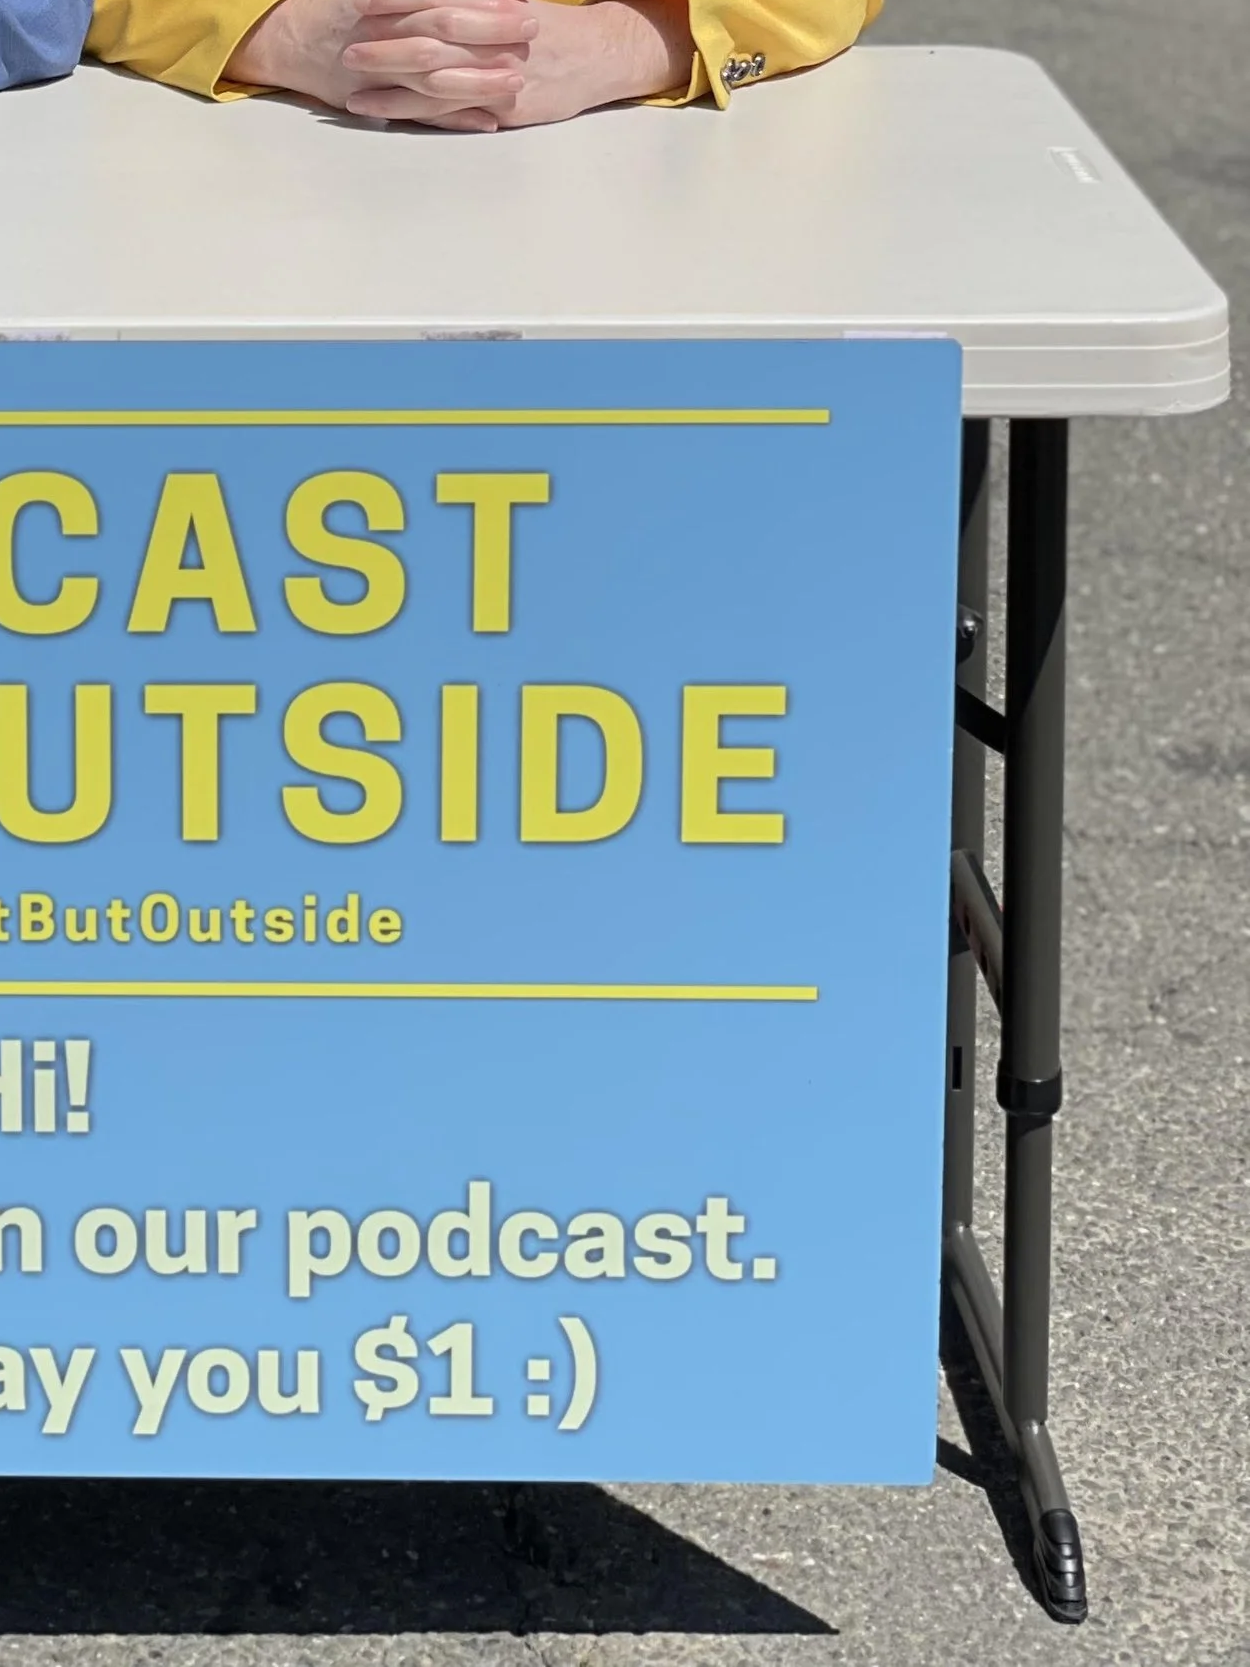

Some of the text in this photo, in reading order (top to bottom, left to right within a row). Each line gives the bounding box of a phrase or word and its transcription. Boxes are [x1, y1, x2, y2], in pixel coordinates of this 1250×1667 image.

[74, 1207, 258, 1276] our
[287, 1180, 777, 1299] podcast.
[119, 1347, 321, 1436] you
[352, 1314, 495, 1422] $1
[526, 1316, 598, 1431] :)
